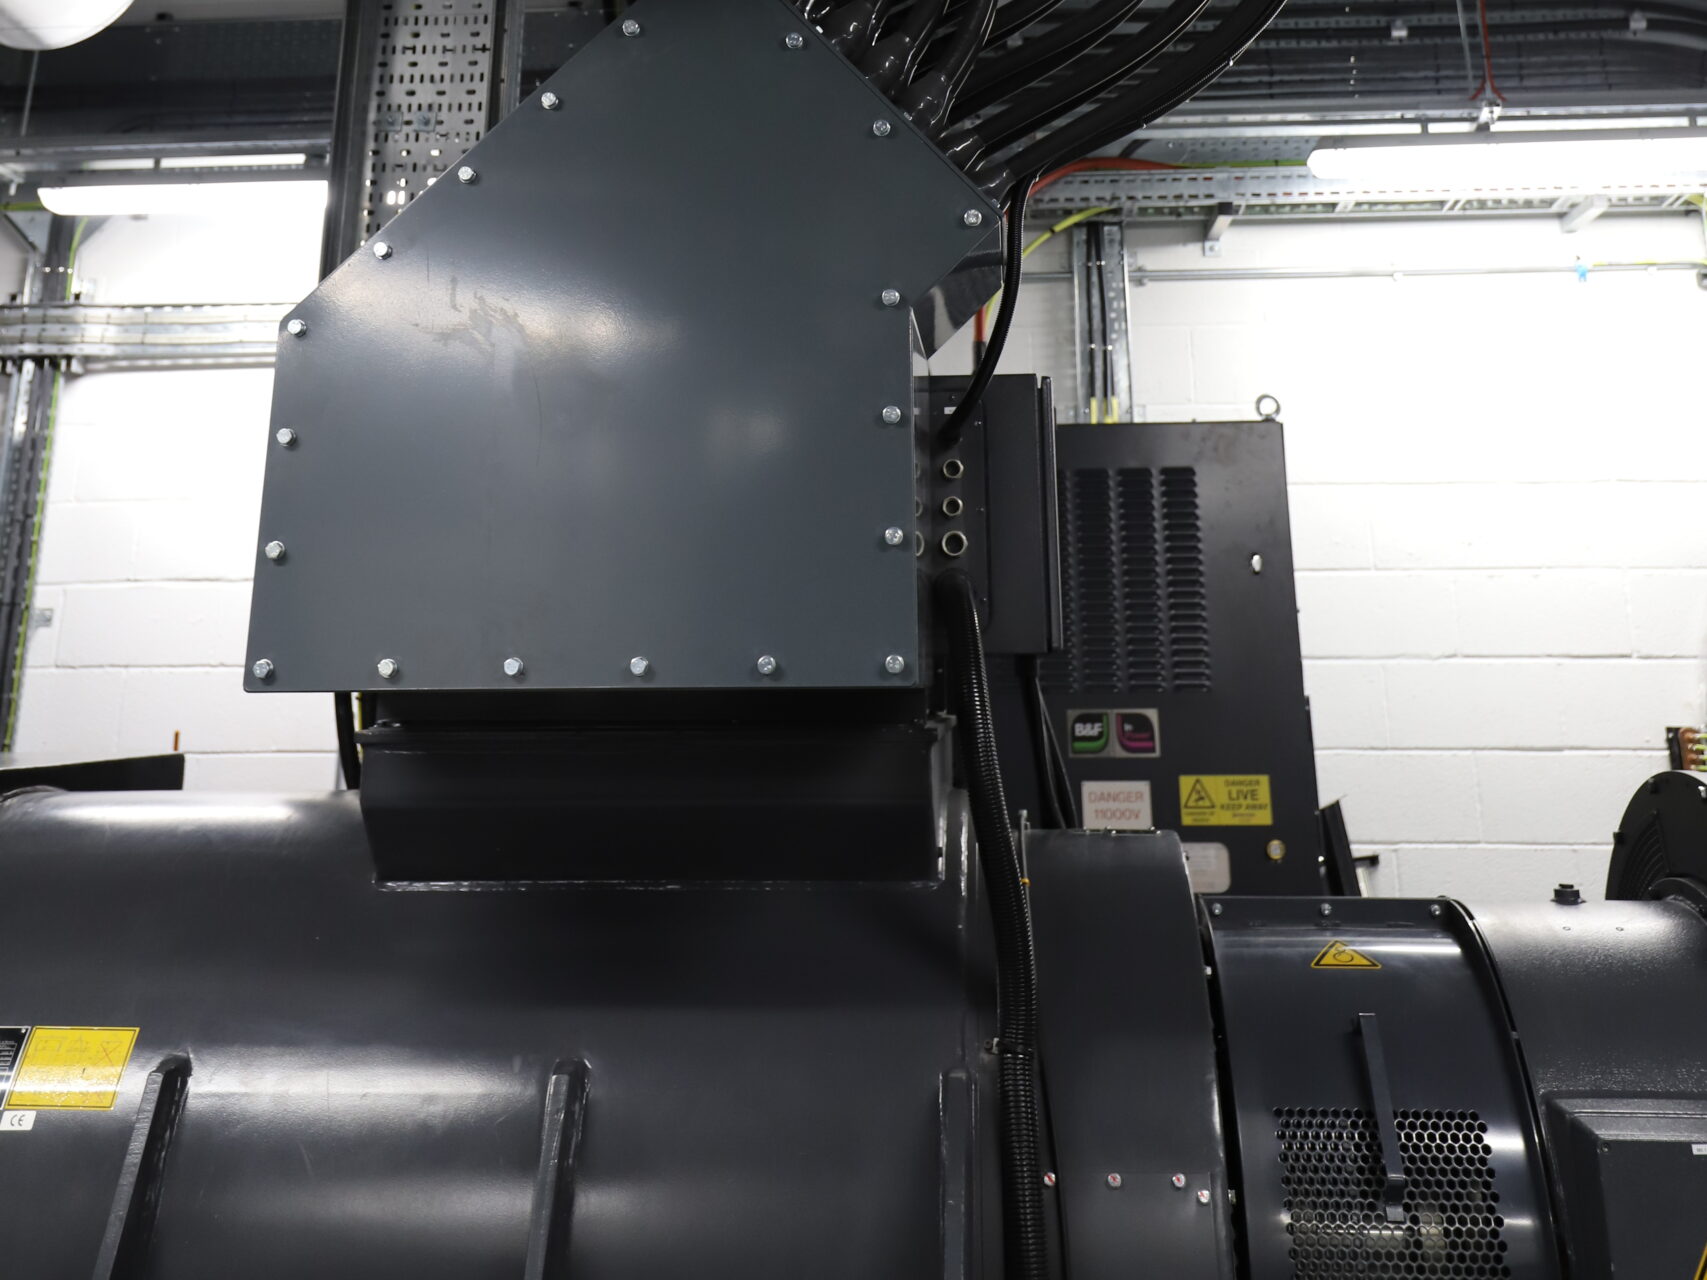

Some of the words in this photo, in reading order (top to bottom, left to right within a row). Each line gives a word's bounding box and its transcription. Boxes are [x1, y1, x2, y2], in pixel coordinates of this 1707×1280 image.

[1074, 722, 1103, 737] B&F
[1224, 778, 1260, 787] DANGER
[1088, 791, 1144, 803] DANGER
[1227, 788, 1258, 801] LIVE
[1094, 807, 1141, 820] 11000V
[10, 1113, 26, 1127] CE
